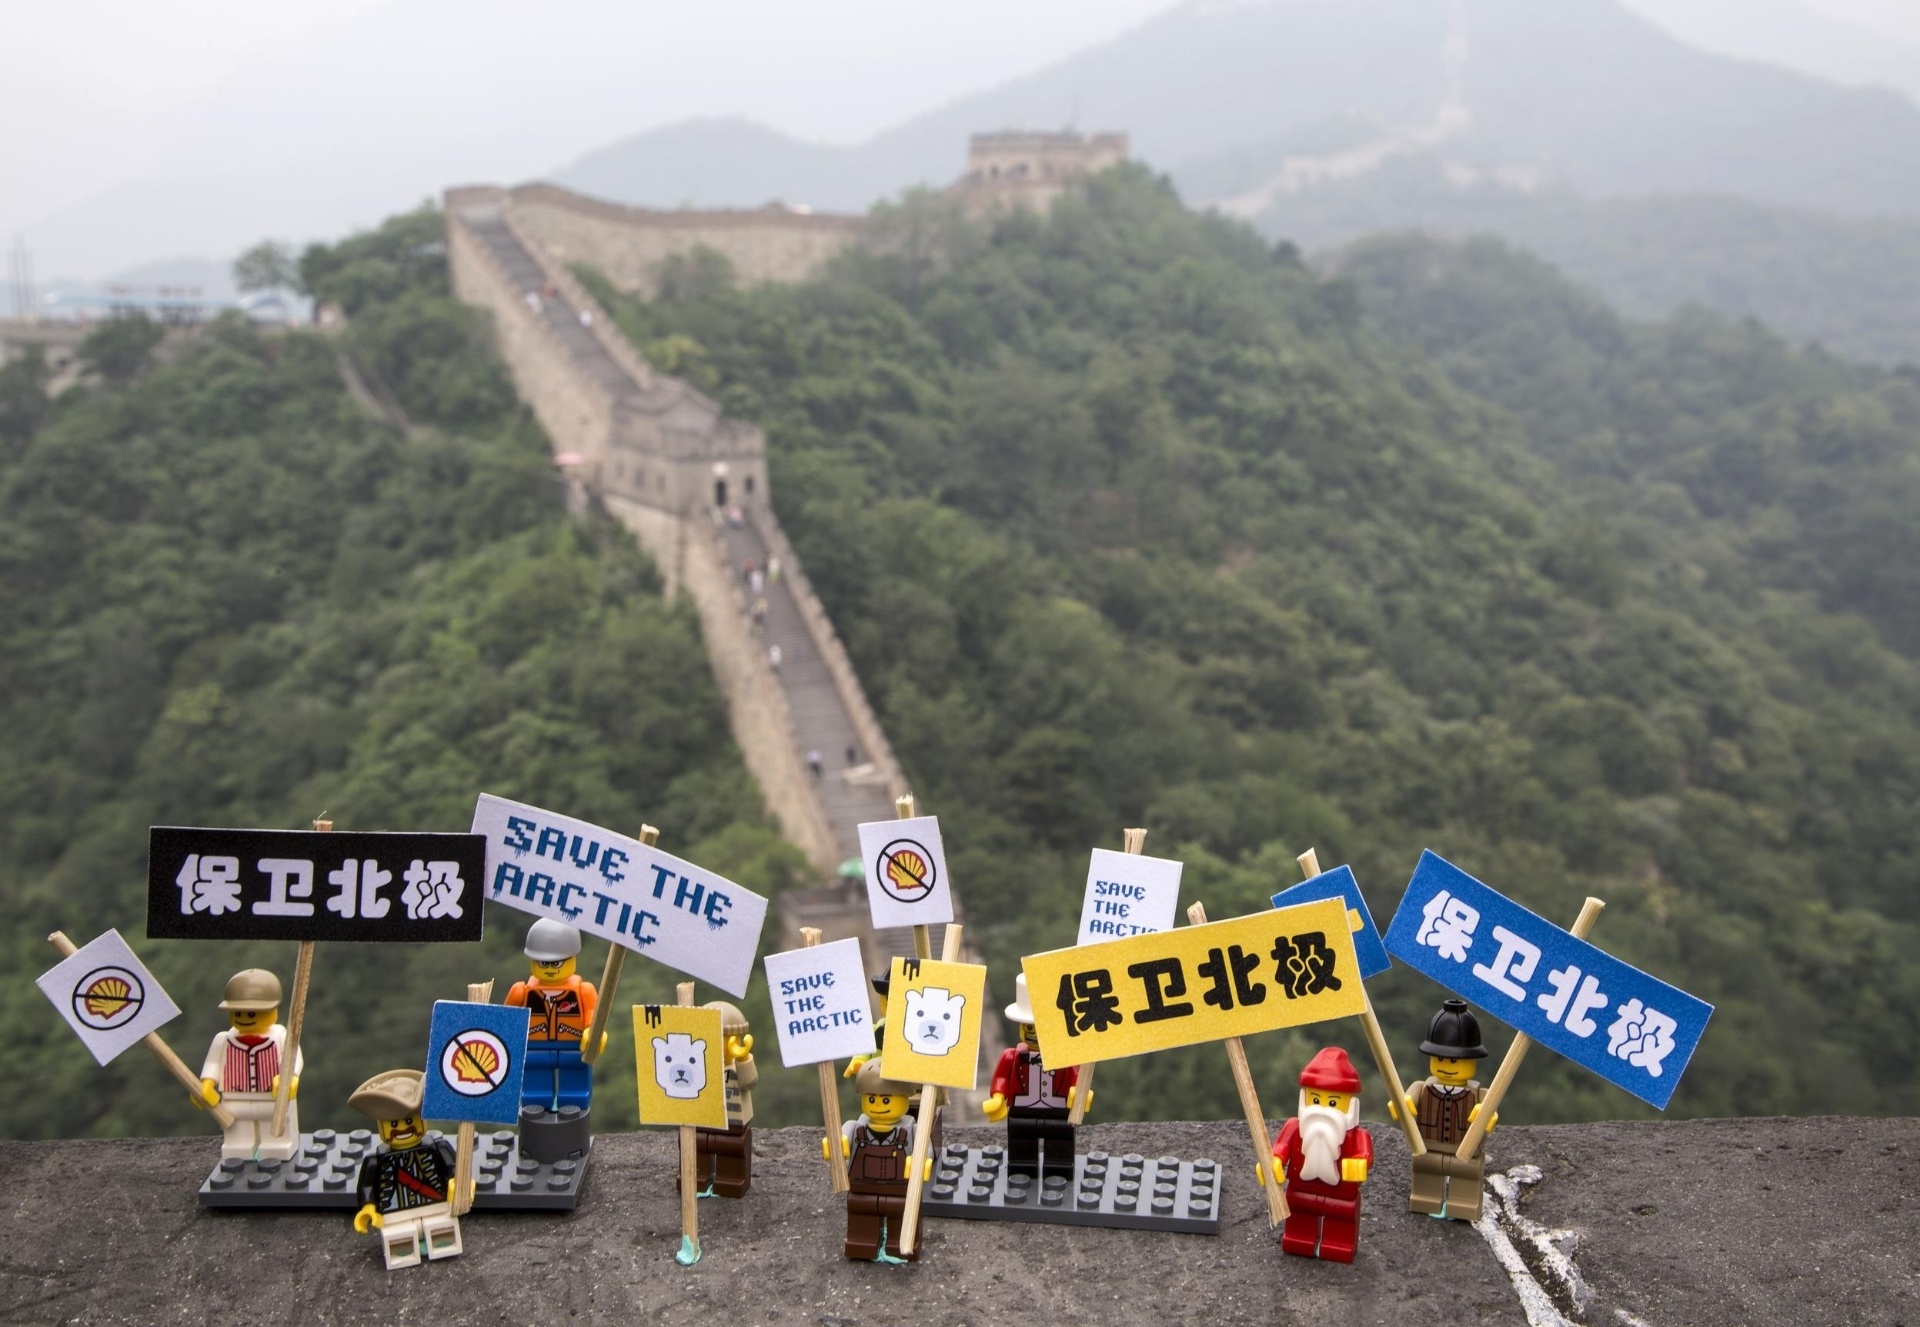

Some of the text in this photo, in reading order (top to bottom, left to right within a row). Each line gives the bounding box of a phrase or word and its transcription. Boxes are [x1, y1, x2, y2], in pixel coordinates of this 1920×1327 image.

[176, 853, 464, 920] 保卫北极
[504, 816, 733, 930] SAVE THE
[1095, 880, 1146, 901] SAVE
[493, 862, 660, 948] ARCTIC
[1094, 899, 1130, 919] THE
[780, 971, 835, 997] SAVE
[784, 995, 825, 1015] THE
[1056, 931, 1342, 1037] 保卫北极
[1415, 890, 1677, 1077] 保卫北极
[788, 1009, 862, 1037] ARCTIC
